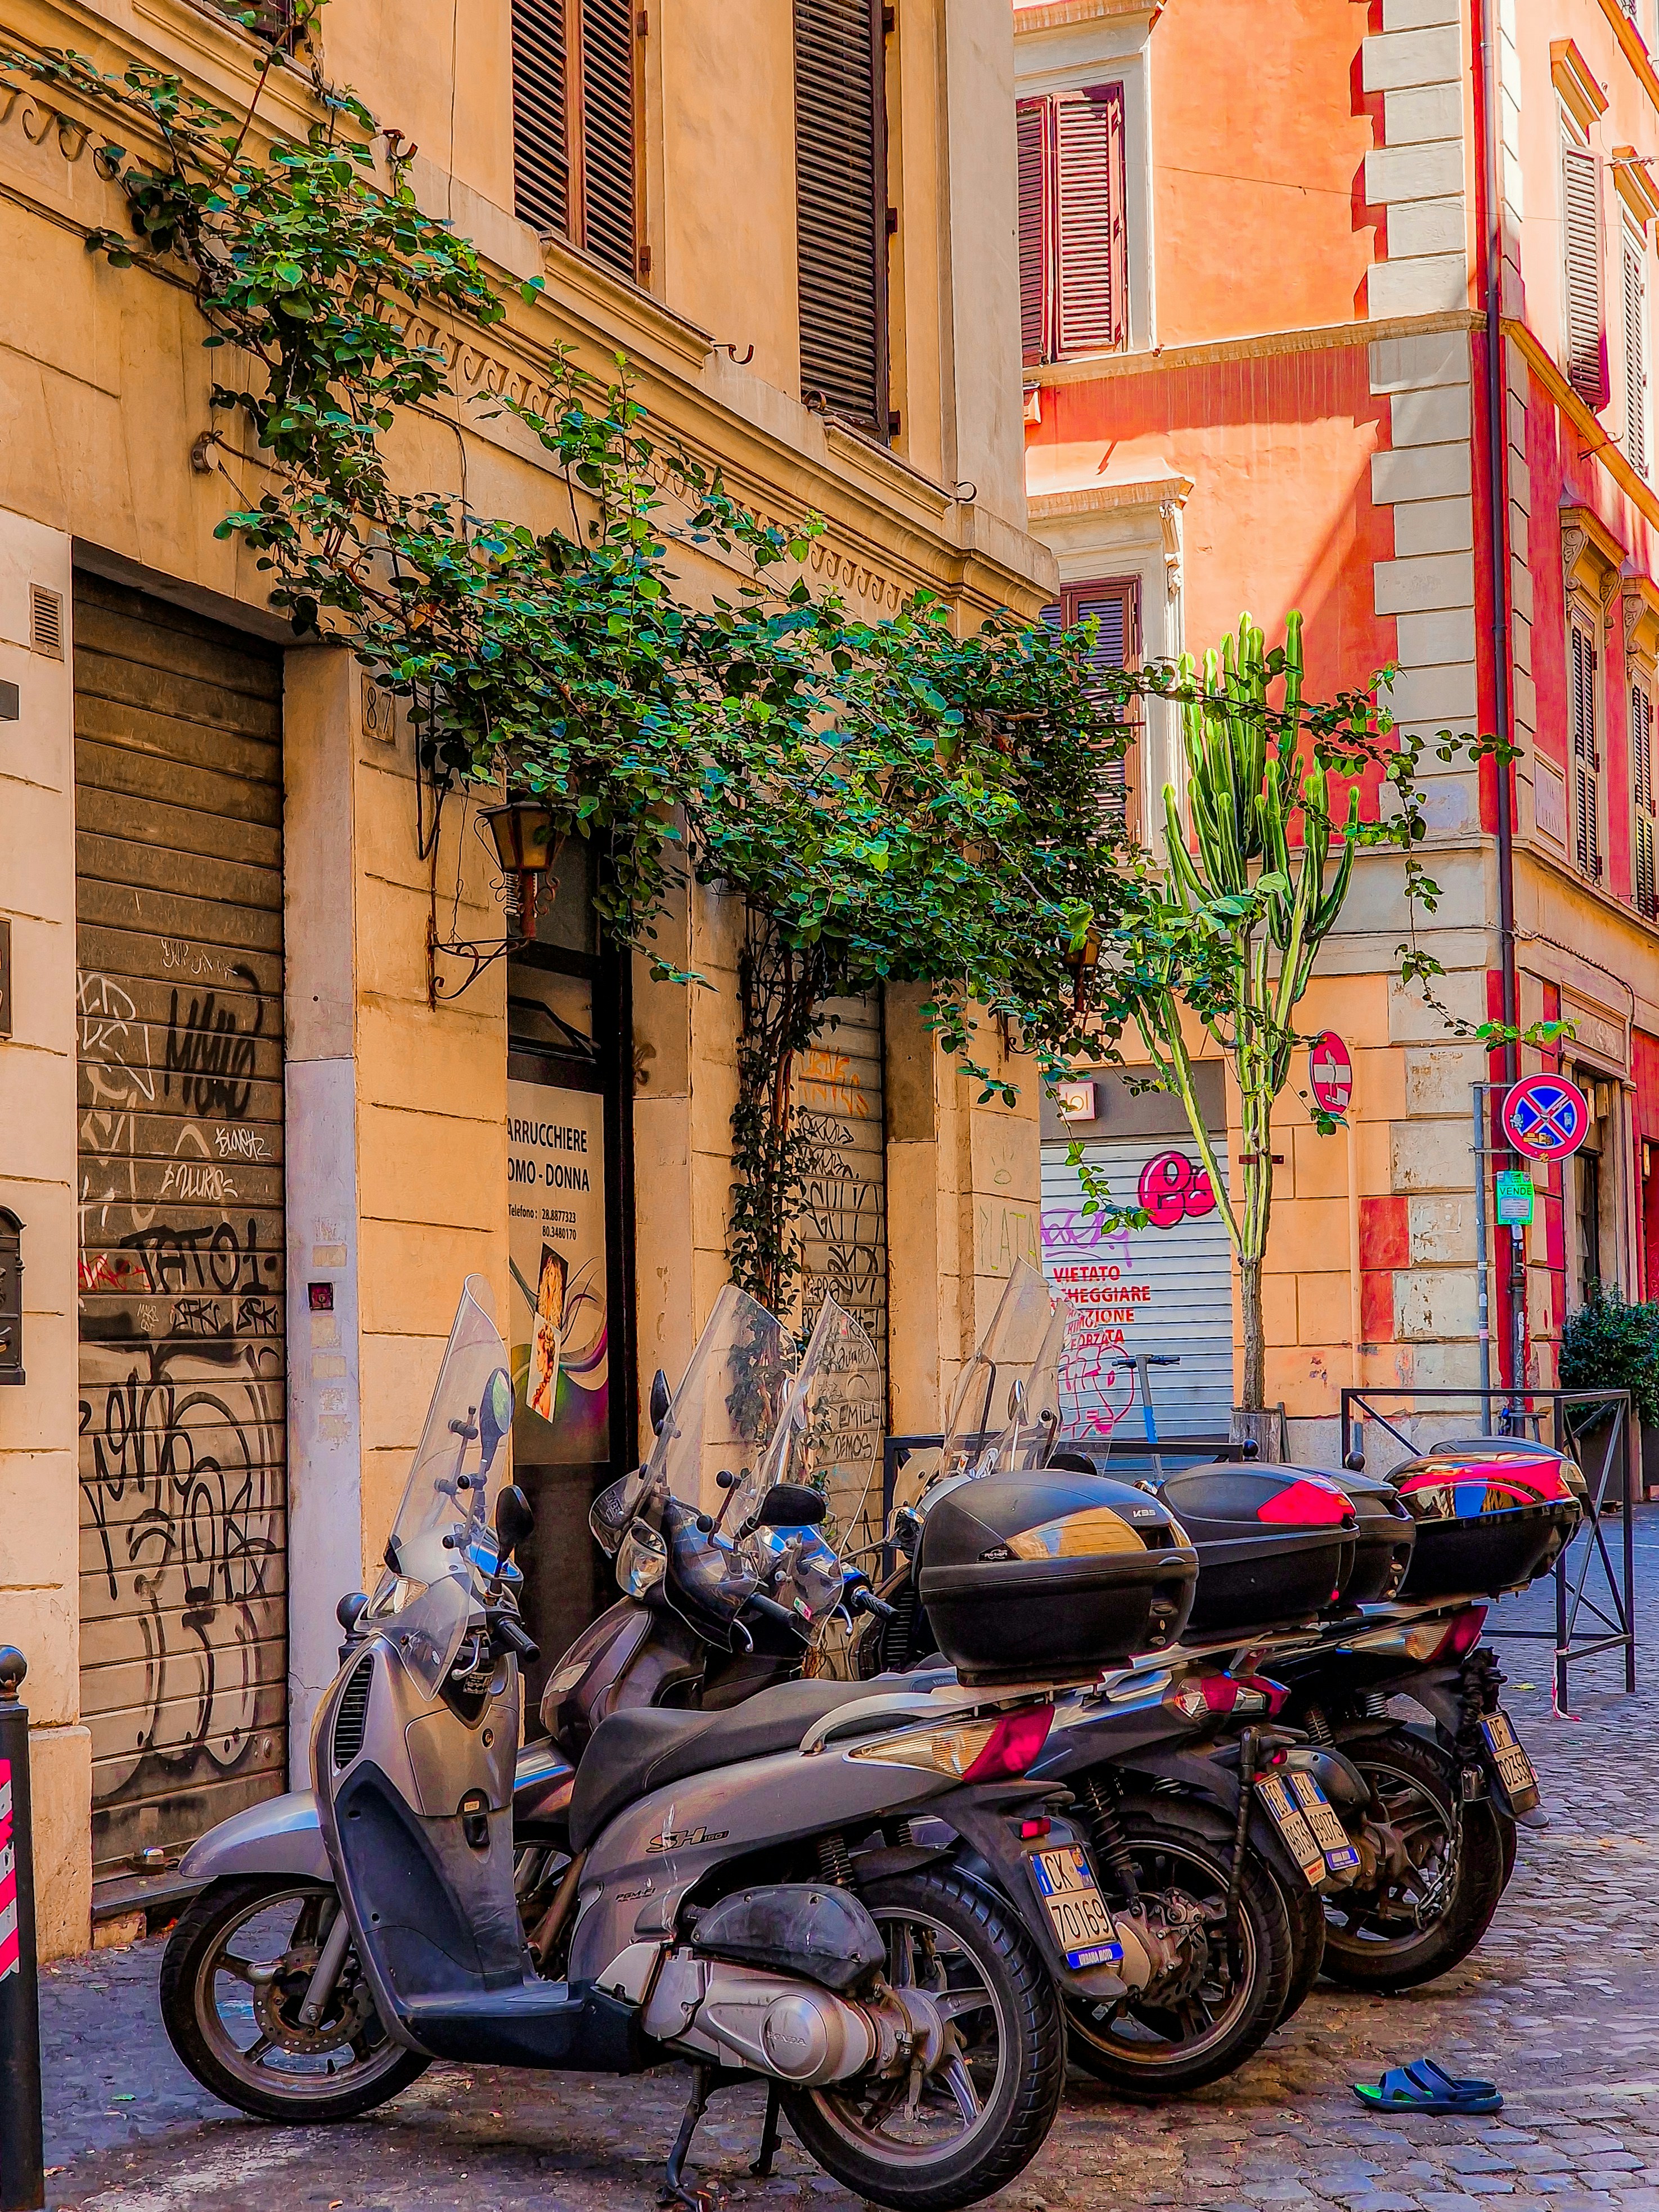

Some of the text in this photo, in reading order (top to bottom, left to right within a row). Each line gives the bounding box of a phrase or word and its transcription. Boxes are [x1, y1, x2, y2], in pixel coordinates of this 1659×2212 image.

[366, 686, 392, 734] 87
[507, 1117, 588, 1153] ARRUCCHIERE
[507, 1157, 536, 1184] OMO
[546, 1163, 590, 1192] DONNA
[1499, 1187, 1532, 1195] VENDE
[1053, 1266, 1121, 1283] VIETATO
[1489, 1719, 1505, 1748] DF
[1267, 1783, 1288, 1815] EC
[1294, 1776, 1316, 1804] EK
[646, 1826, 707, 1853] SH
[1309, 1811, 1344, 1842] 99073
[1045, 1853, 1074, 1890] CK
[1051, 1898, 1110, 1943] 70169
